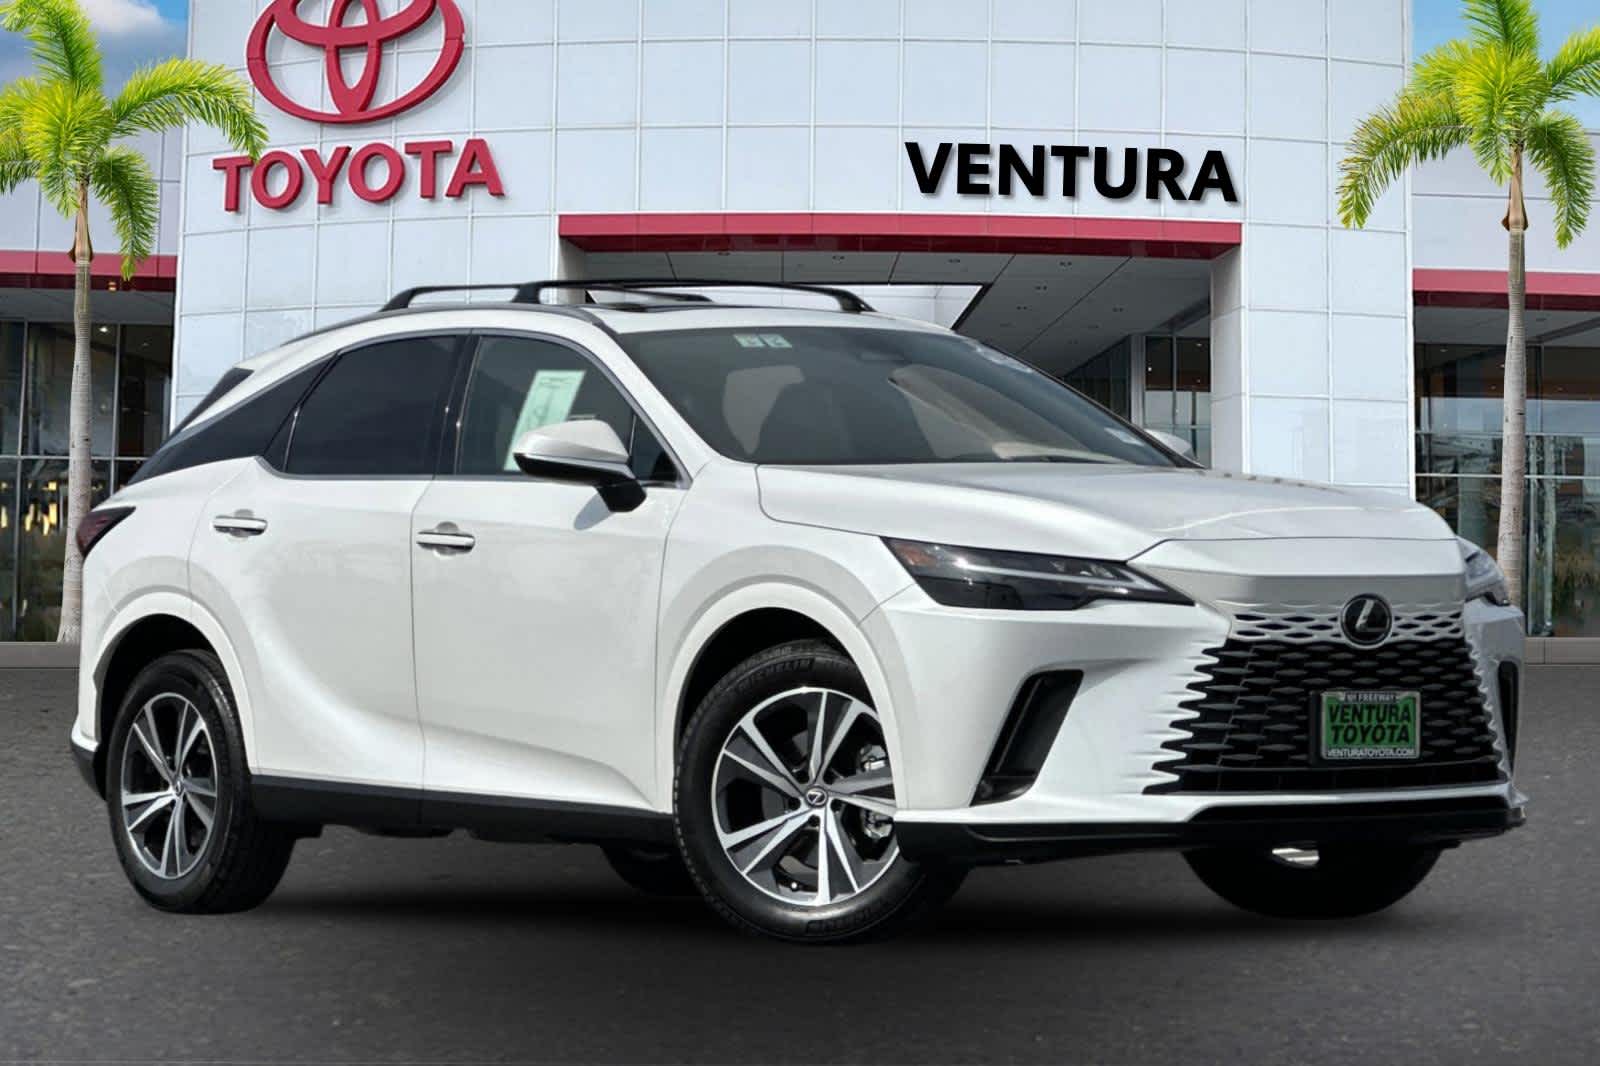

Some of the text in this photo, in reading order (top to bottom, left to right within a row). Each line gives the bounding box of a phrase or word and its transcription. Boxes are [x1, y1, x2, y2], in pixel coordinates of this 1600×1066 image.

[212, 138, 505, 212] TOYOTA
[904, 141, 1239, 203] VENTURA
[1359, 693, 1395, 701] FREEWAY
[1328, 703, 1412, 723] VENTURA
[1330, 724, 1411, 744] TOYOTA
[1327, 747, 1415, 757] VENTURATOYOTA.COM
